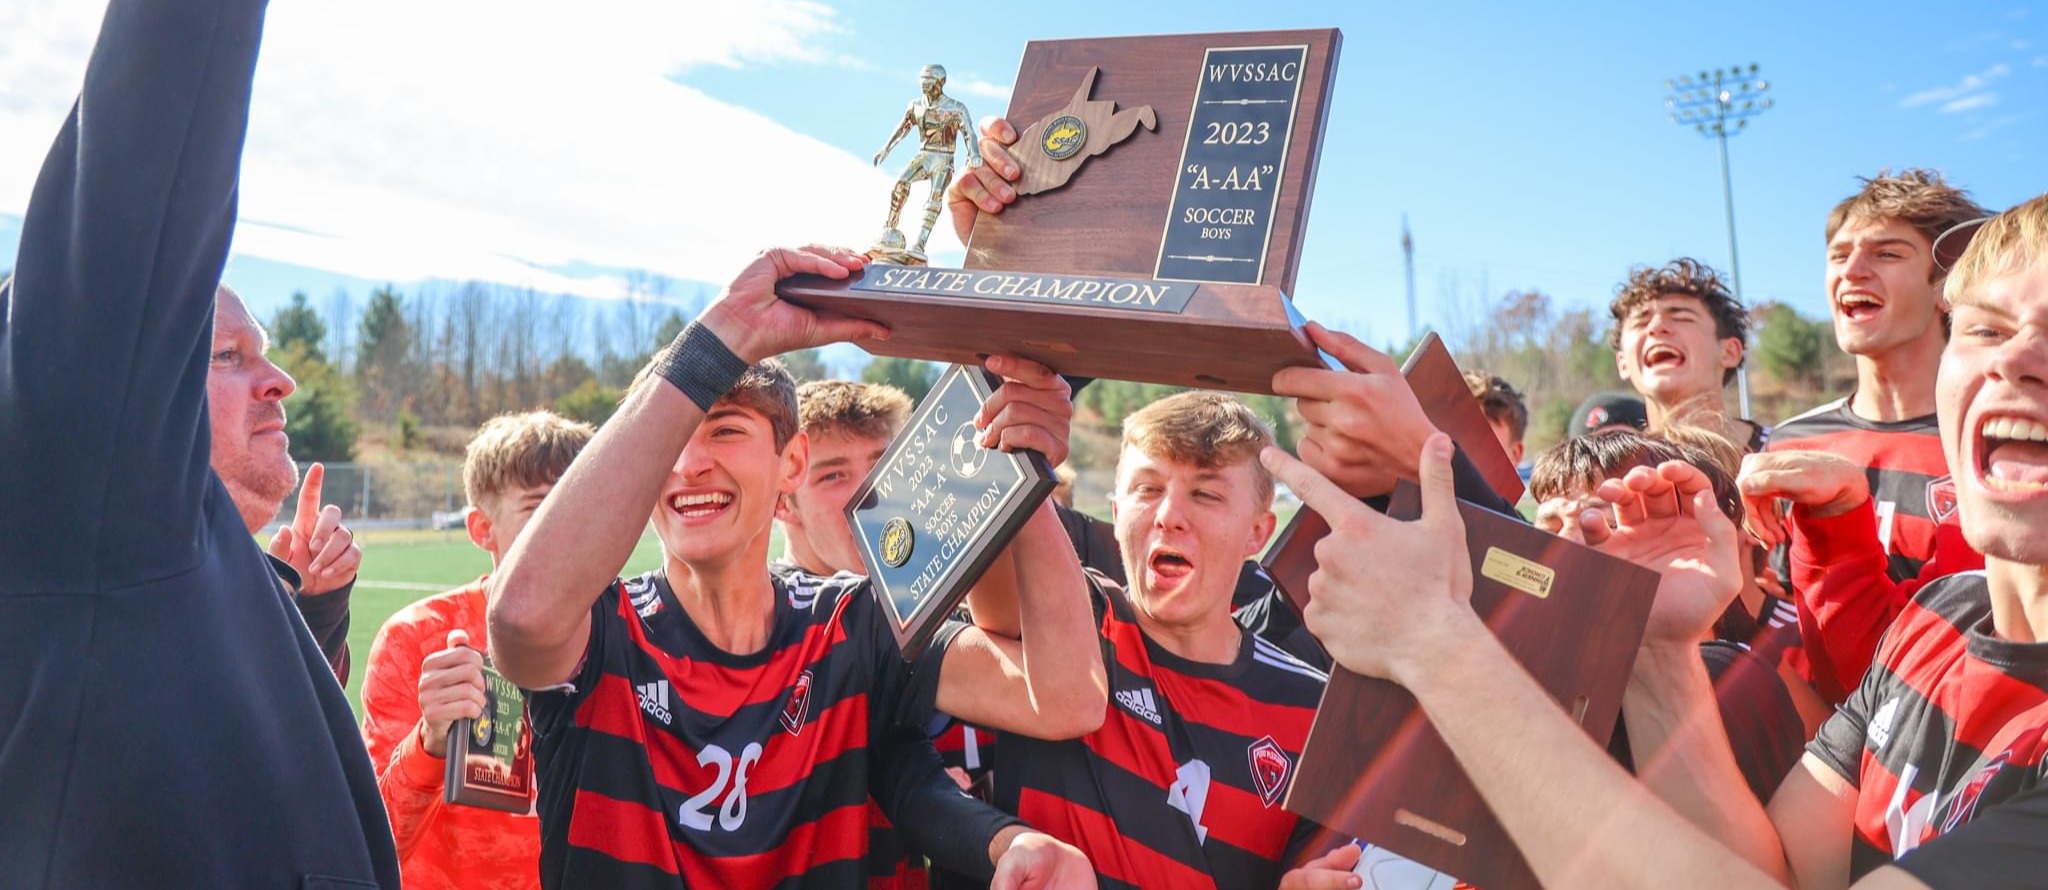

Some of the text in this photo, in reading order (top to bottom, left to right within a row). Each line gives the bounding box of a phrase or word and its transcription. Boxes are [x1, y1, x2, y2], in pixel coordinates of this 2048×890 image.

[1209, 62, 1296, 83] WVSSAC
[1203, 121, 1271, 145] 2023
[1187, 164, 1274, 191] “A-AA”
[1183, 207, 1255, 226] SOCCER
[1200, 227, 1232, 240] BOYS
[875, 268, 1170, 307] STATE CHAMPION
[878, 405, 949, 500] WVSSAC
[908, 457, 935, 492] 2023
[910, 464, 947, 516] “AA-A”
[924, 492, 957, 535] SOCCER
[936, 510, 959, 542] BOYS
[909, 481, 1001, 601] STATE CHAMPION
[486, 674, 523, 702] WVSSAC
[638, 694, 672, 725] didas
[1115, 691, 1162, 725] adidas
[474, 767, 491, 783] STATE
[679, 742, 763, 832] 28
[1166, 758, 1211, 847] 4
